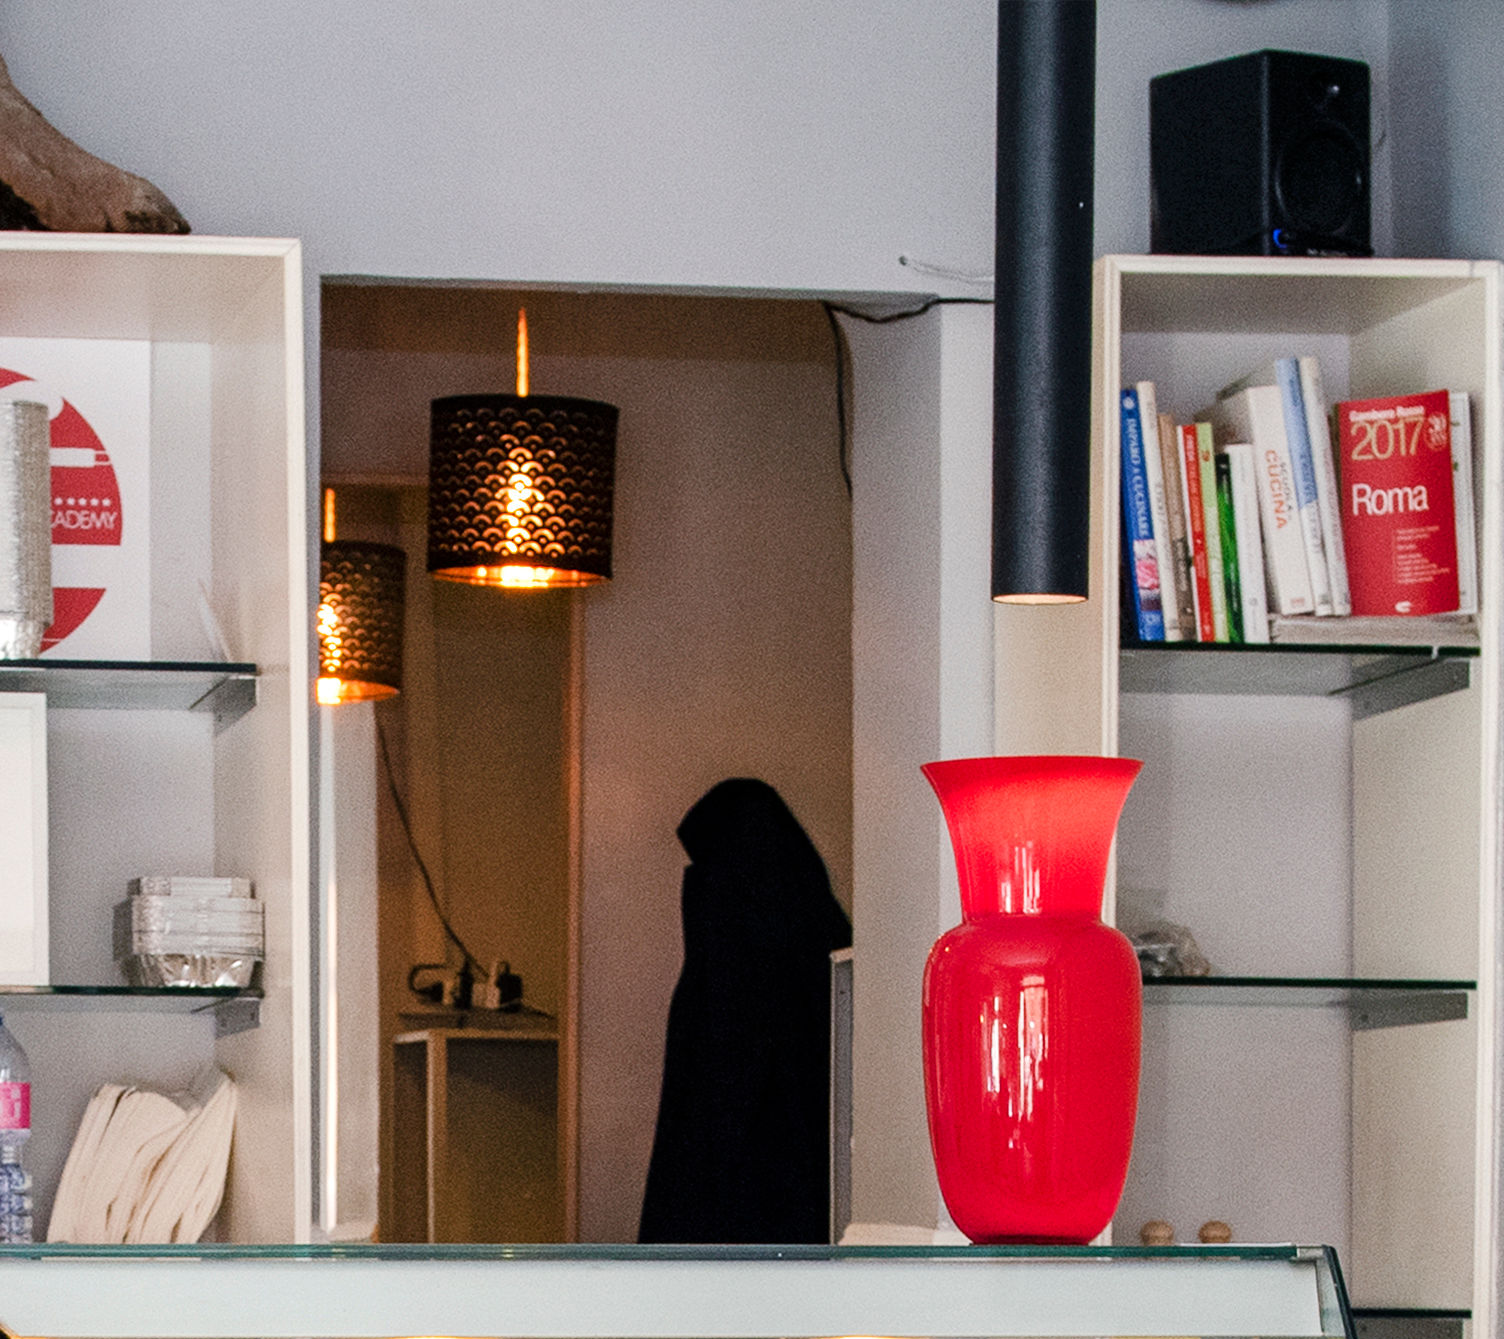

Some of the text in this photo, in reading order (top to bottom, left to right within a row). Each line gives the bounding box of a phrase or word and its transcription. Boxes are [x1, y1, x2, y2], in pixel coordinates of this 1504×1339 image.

[1351, 415, 1425, 461] 2017
[1264, 449, 1288, 529] CUCINA
[1352, 483, 1430, 516] Roma
[50, 510, 118, 530] ADEMY
